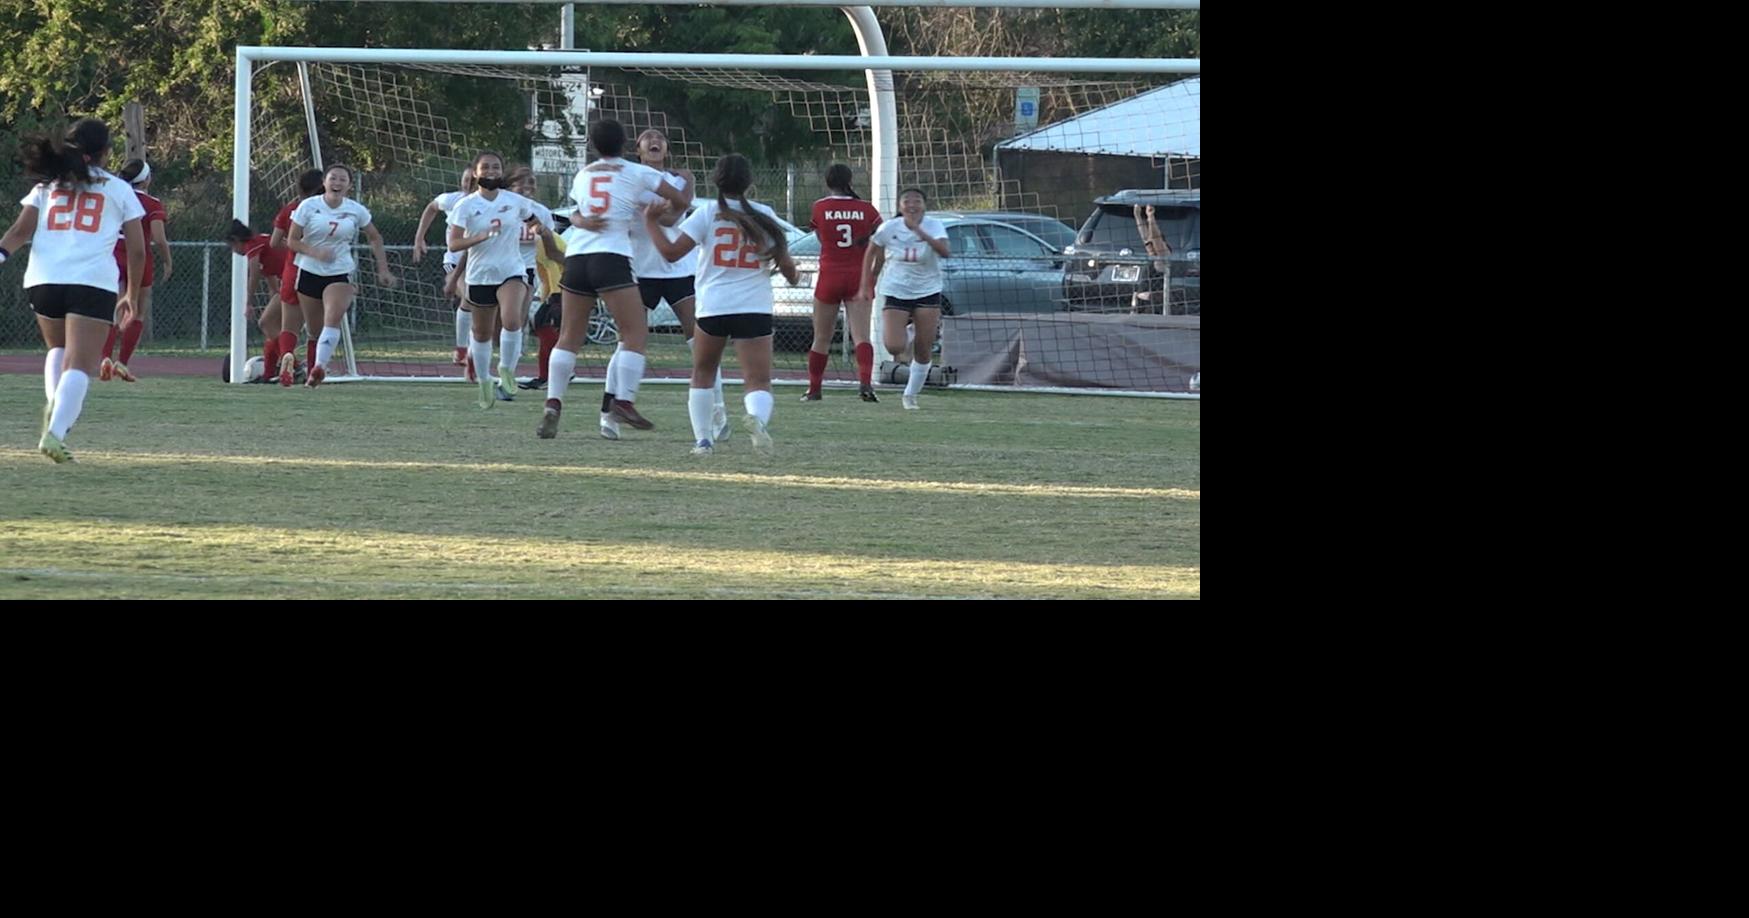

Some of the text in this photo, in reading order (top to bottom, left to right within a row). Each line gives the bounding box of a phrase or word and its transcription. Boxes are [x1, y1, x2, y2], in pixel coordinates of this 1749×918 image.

[590, 176, 612, 213] 5
[47, 188, 105, 233] 28
[825, 210, 864, 220] KAUAI
[328, 221, 338, 236] 7
[836, 224, 852, 247] 3
[904, 247, 917, 262] 11
